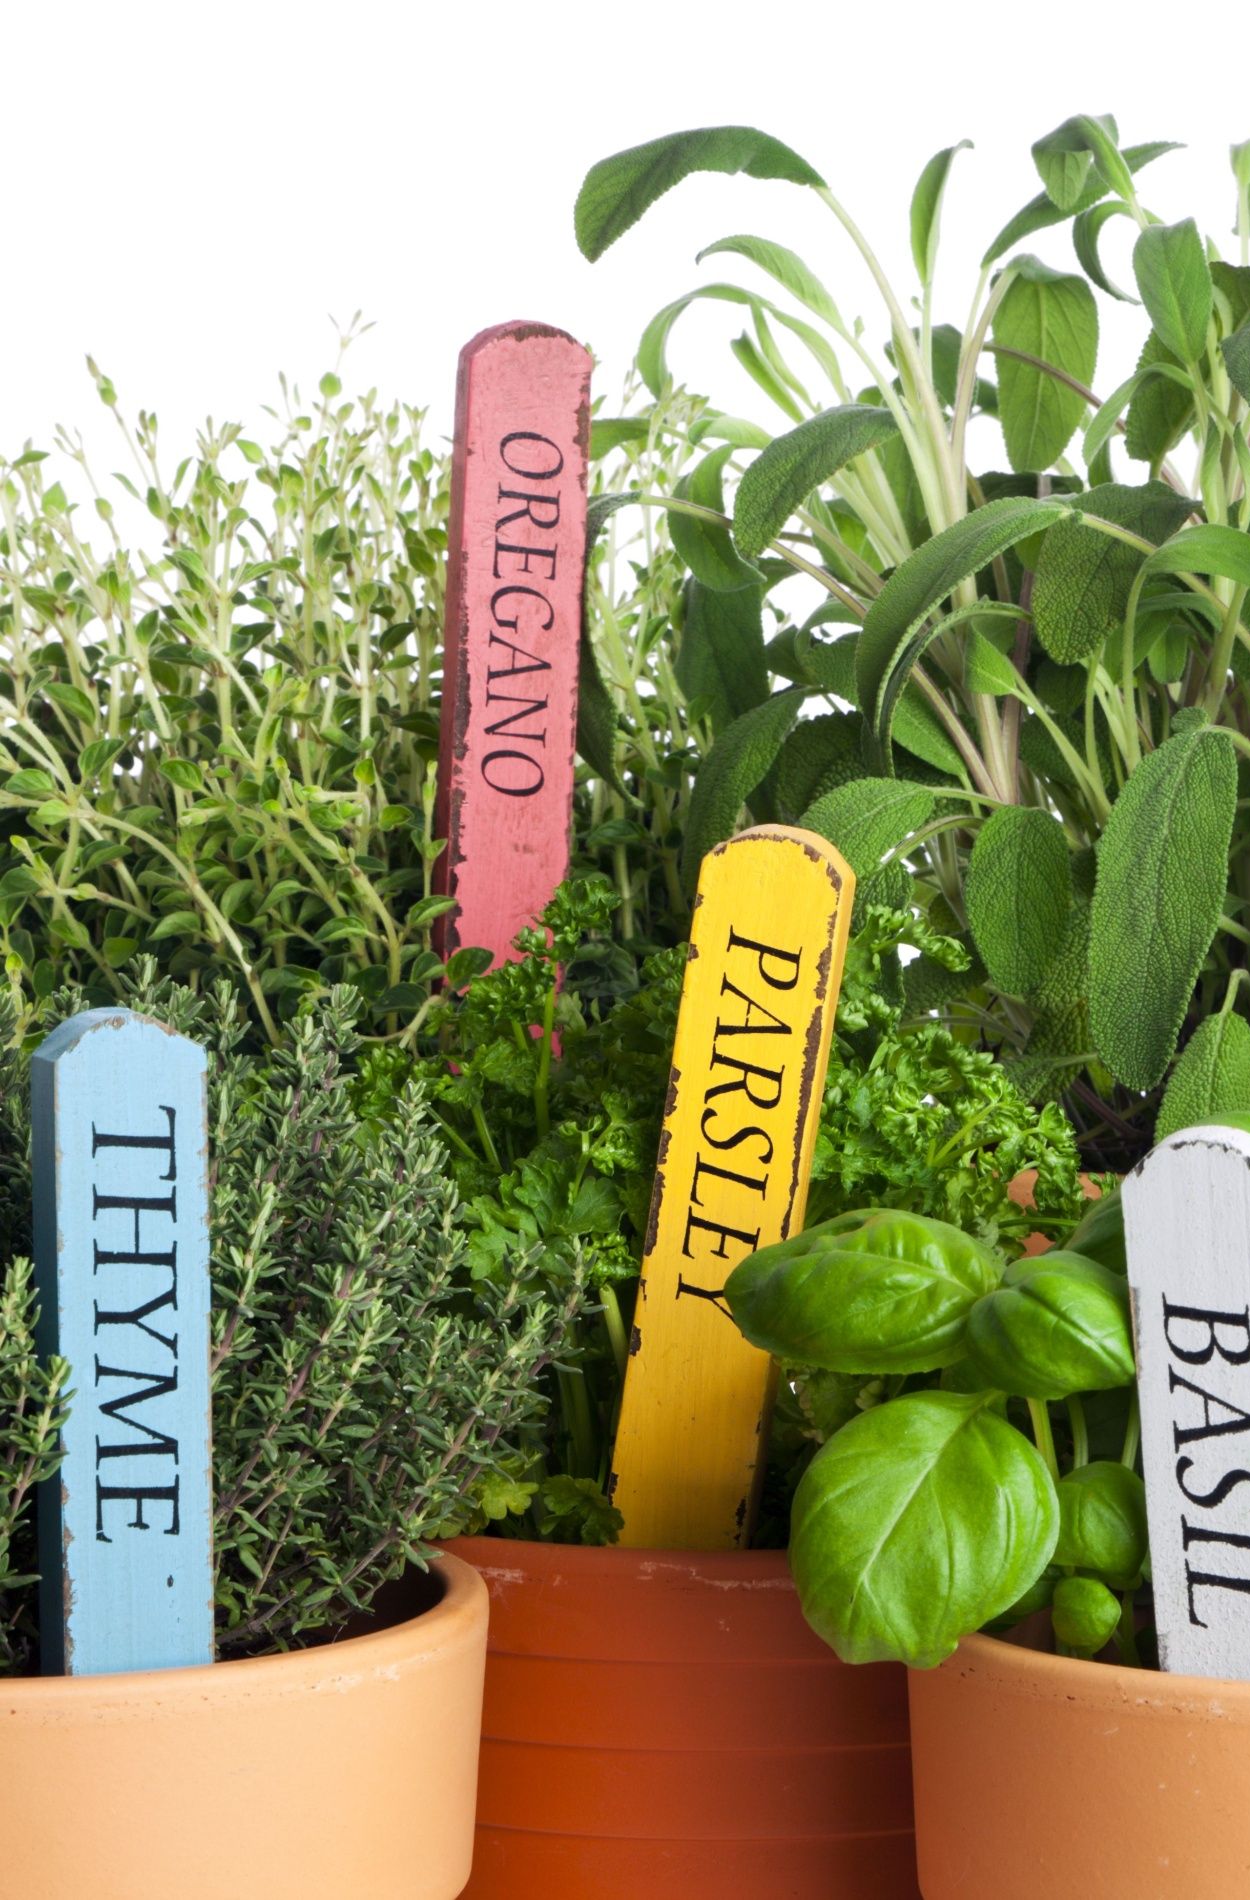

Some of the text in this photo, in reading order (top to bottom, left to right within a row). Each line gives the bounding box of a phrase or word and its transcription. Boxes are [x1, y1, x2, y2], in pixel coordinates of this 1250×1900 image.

[481, 430, 564, 798] OREGANO
[91, 1105, 179, 1543] THYME
[676, 924, 803, 1337] PARSLEY
